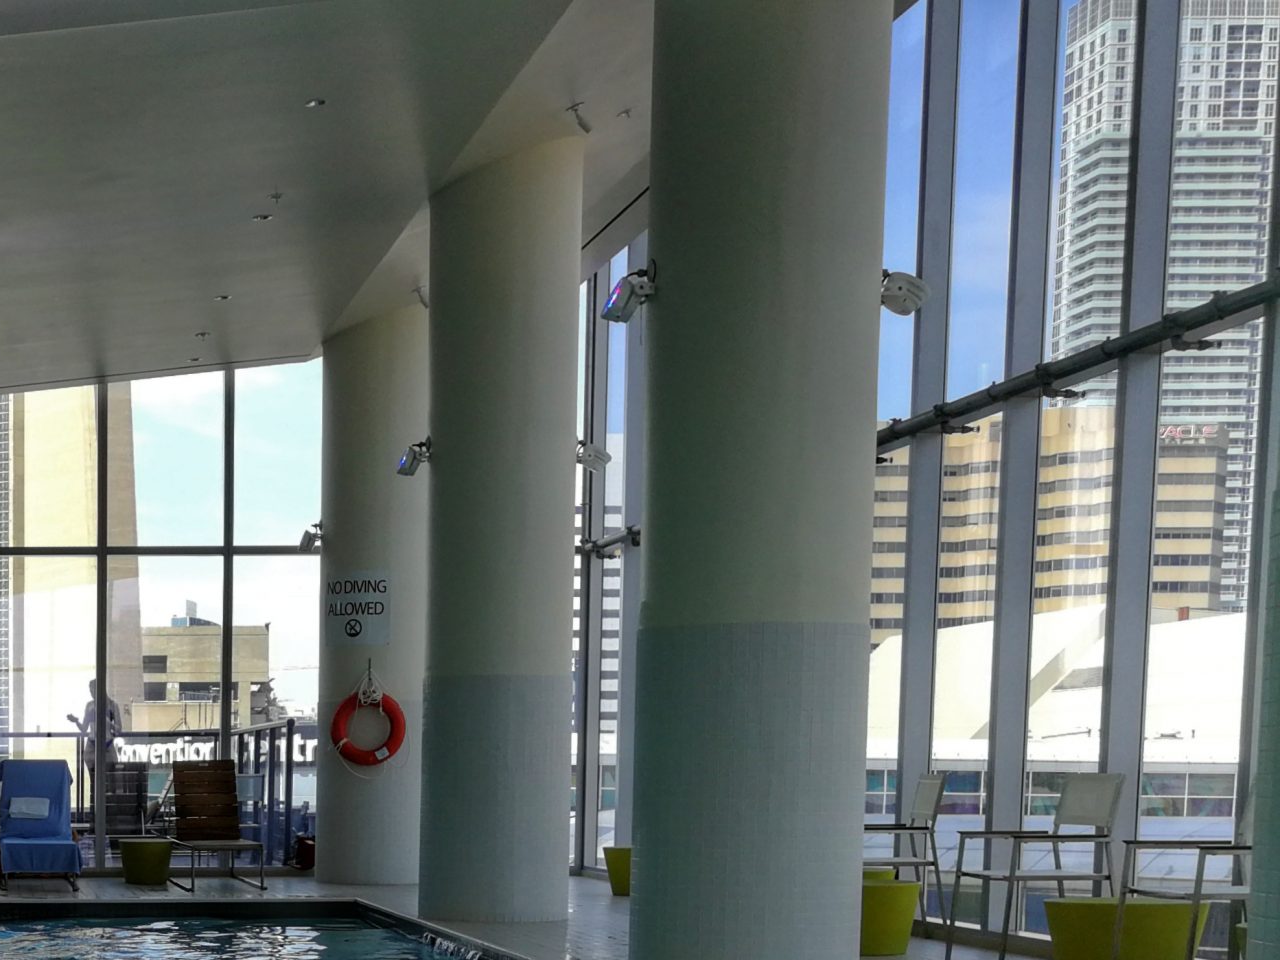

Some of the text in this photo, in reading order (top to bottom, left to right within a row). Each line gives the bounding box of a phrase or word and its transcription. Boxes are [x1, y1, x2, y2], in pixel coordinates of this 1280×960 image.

[1159, 424, 1219, 438] ACLE
[327, 580, 387, 595] NO DIVING
[328, 602, 385, 616] ALLOWED
